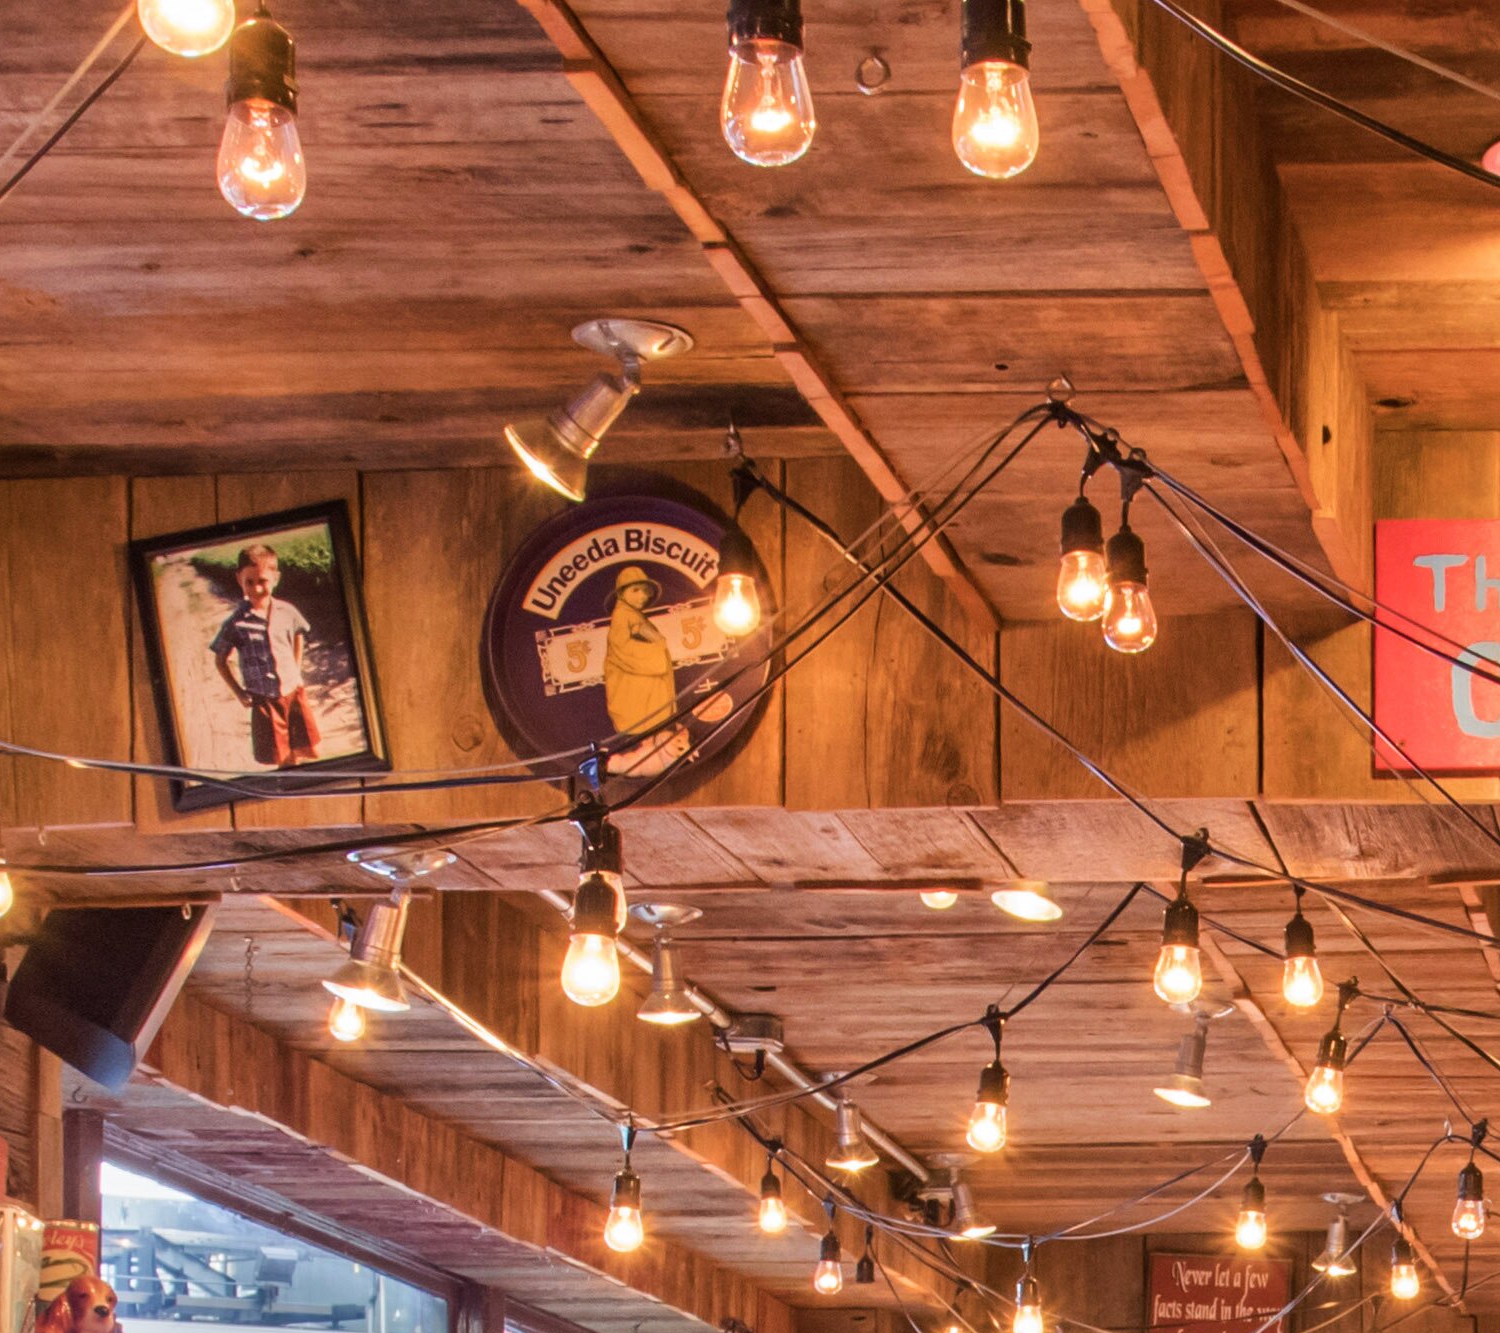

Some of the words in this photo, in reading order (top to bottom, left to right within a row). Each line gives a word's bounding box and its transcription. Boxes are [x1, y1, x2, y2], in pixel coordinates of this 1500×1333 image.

[532, 538, 620, 611] Uneeda
[624, 529, 718, 581] Biscuit
[1172, 1261, 1213, 1293] Never
[1215, 1264, 1230, 1287] let
[1233, 1272, 1241, 1287] a
[1240, 1265, 1269, 1308] few
[1153, 1294, 1182, 1325] facts
[1185, 1297, 1217, 1320] stand
[1221, 1299, 1232, 1320] in
[1235, 1301, 1254, 1322] the
